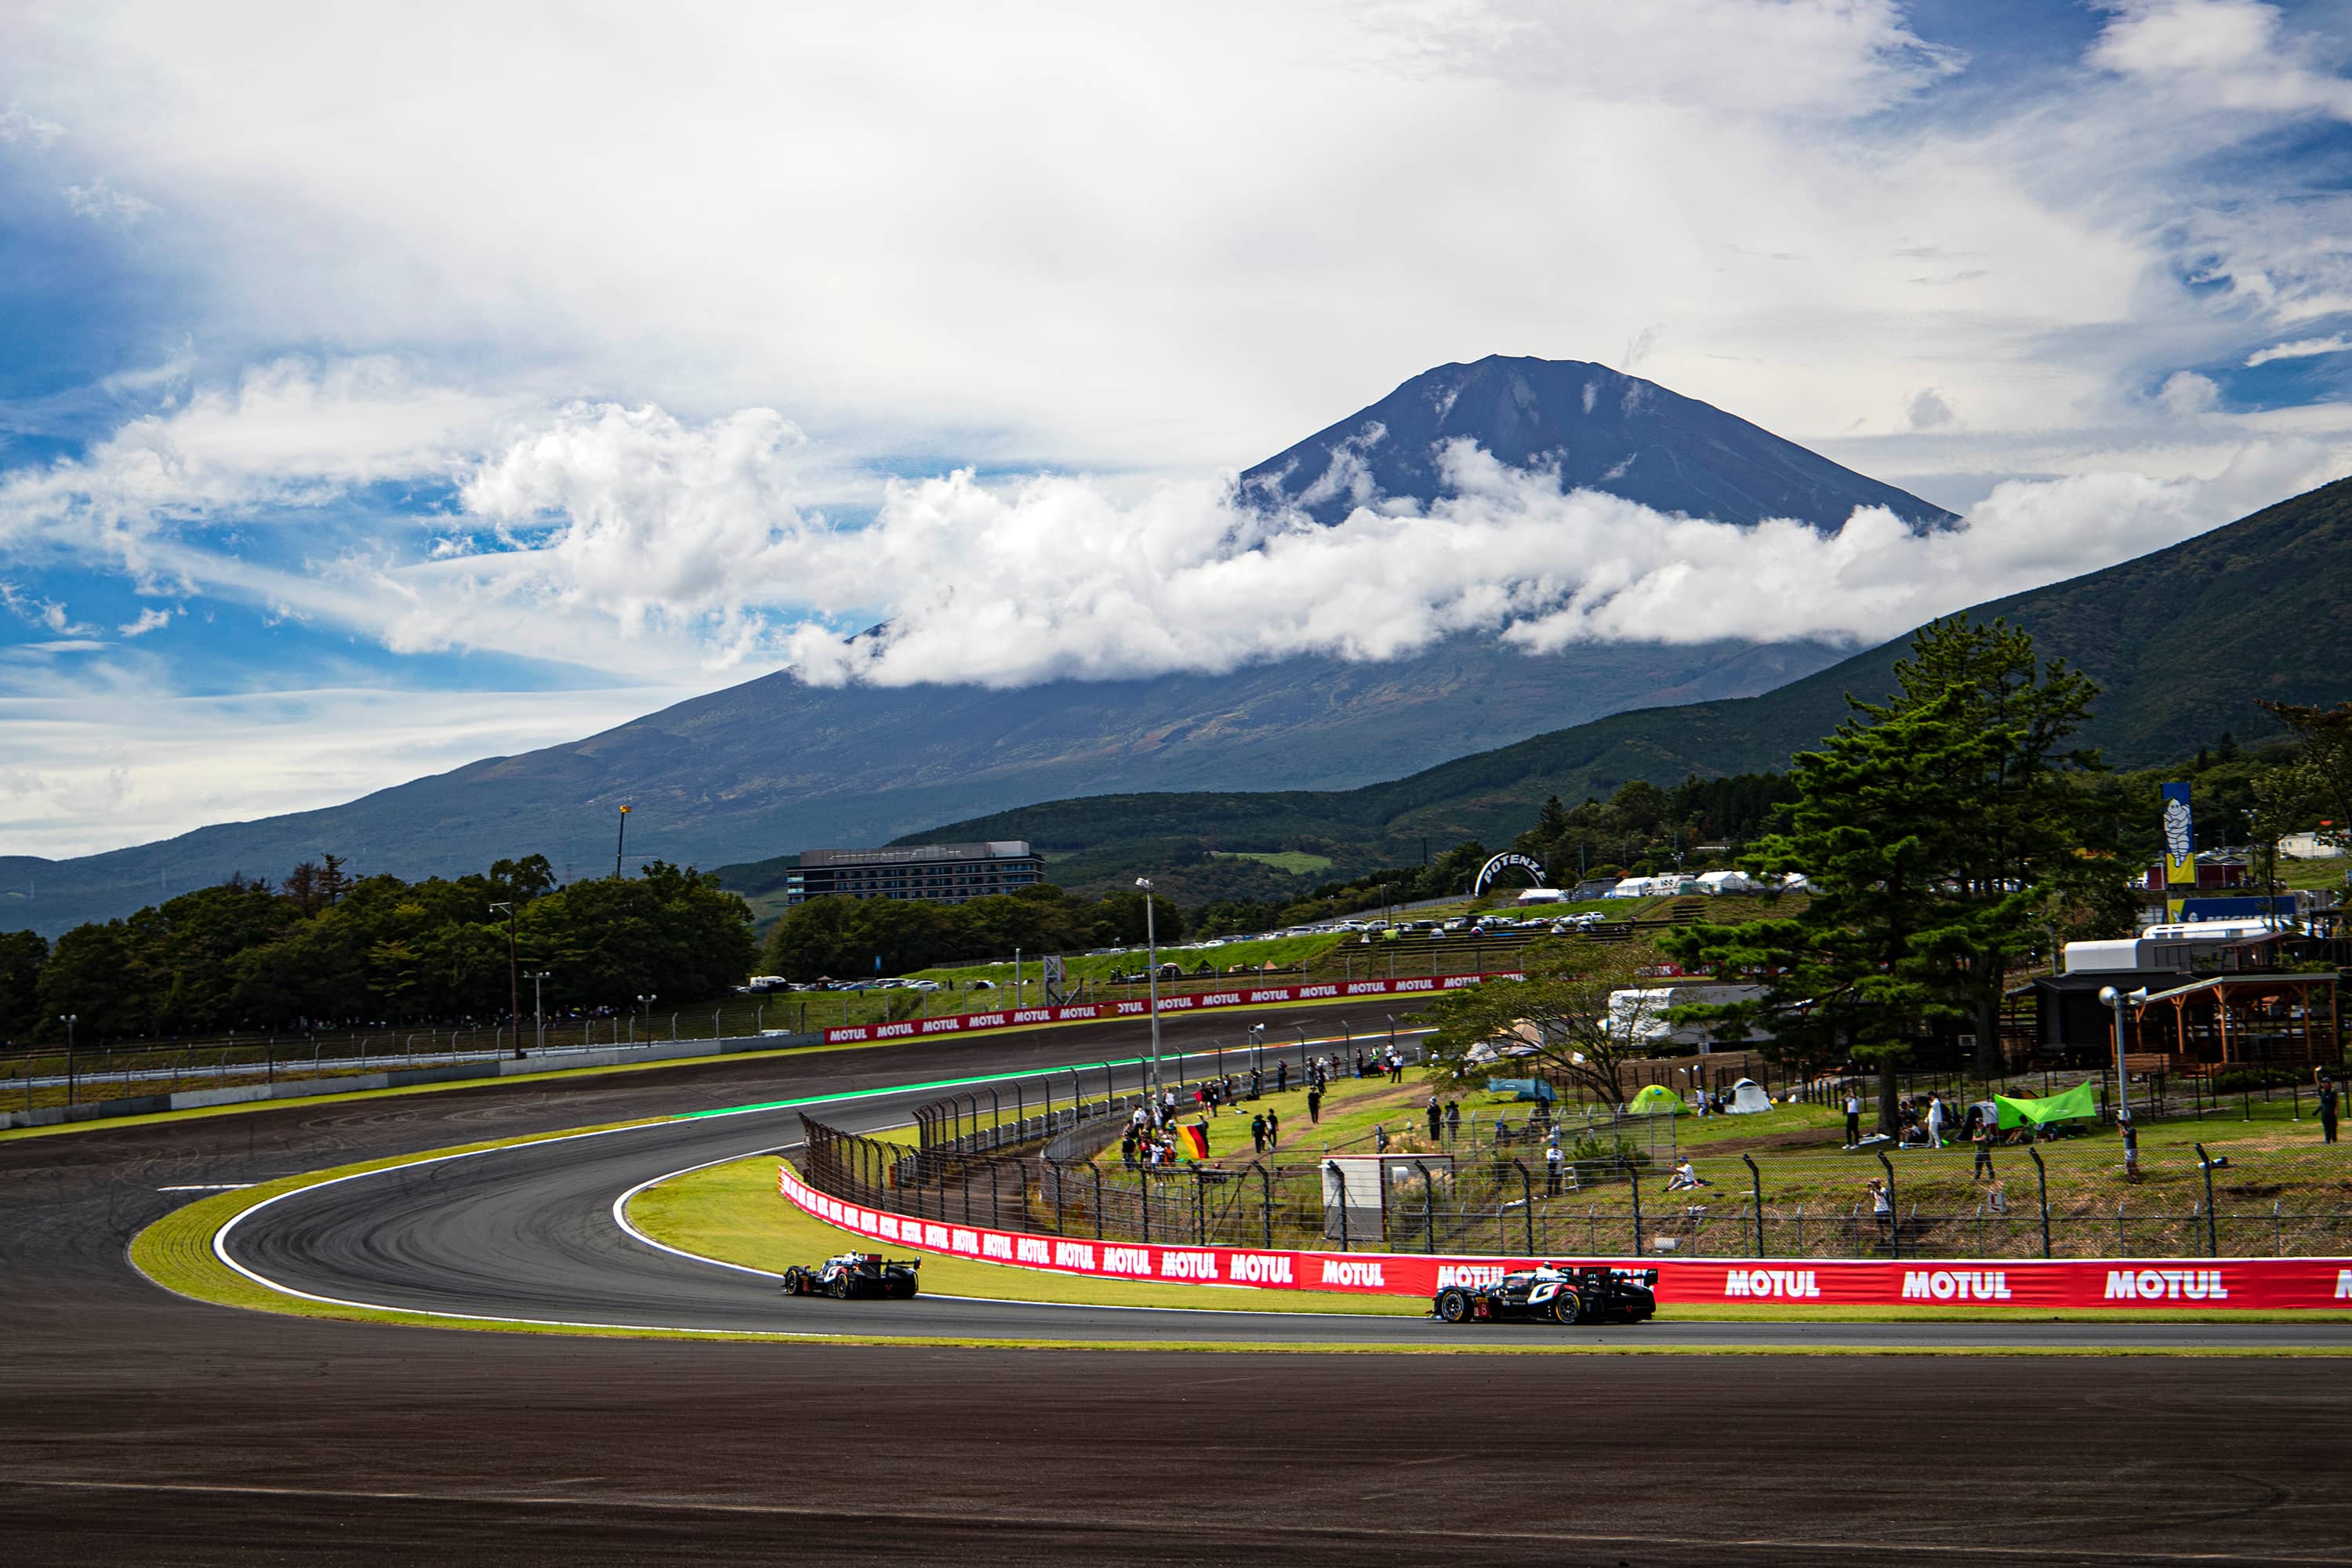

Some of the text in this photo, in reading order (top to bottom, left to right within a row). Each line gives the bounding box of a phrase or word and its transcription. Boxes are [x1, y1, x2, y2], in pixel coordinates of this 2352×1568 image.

[1300, 985, 1338, 997] MOTUL
[1347, 982, 1386, 993] MOTUL
[1396, 979, 1434, 991] MOTUL
[1203, 993, 1240, 1006] MOTUL
[1251, 989, 1290, 1002] MOTUL
[1117, 1001, 1144, 1014] OTUL
[1157, 996, 1193, 1010] MOTUL
[1014, 1010, 1051, 1022] MOTUL
[1060, 1007, 1096, 1018] MOTUL
[922, 1018, 960, 1032] MOTUL
[969, 1014, 1005, 1027] MOTUL
[829, 1028, 867, 1041] MOTUL
[877, 1023, 914, 1037] MOTUL
[983, 1233, 1012, 1260] MOTUL
[1017, 1237, 1050, 1264] MOTUL
[1055, 1242, 1095, 1269] MOTUL
[1103, 1247, 1152, 1275] MOTUL
[1161, 1251, 1218, 1279] MOTUL
[1229, 1254, 1294, 1283] MOTUL
[1322, 1260, 1385, 1287] MOTUL
[1725, 1269, 1820, 1298] MOTUL
[1901, 1271, 2012, 1299] MOTUL
[2103, 1270, 2228, 1299] MOTUL
[1481, 1303, 1487, 1315] 8
